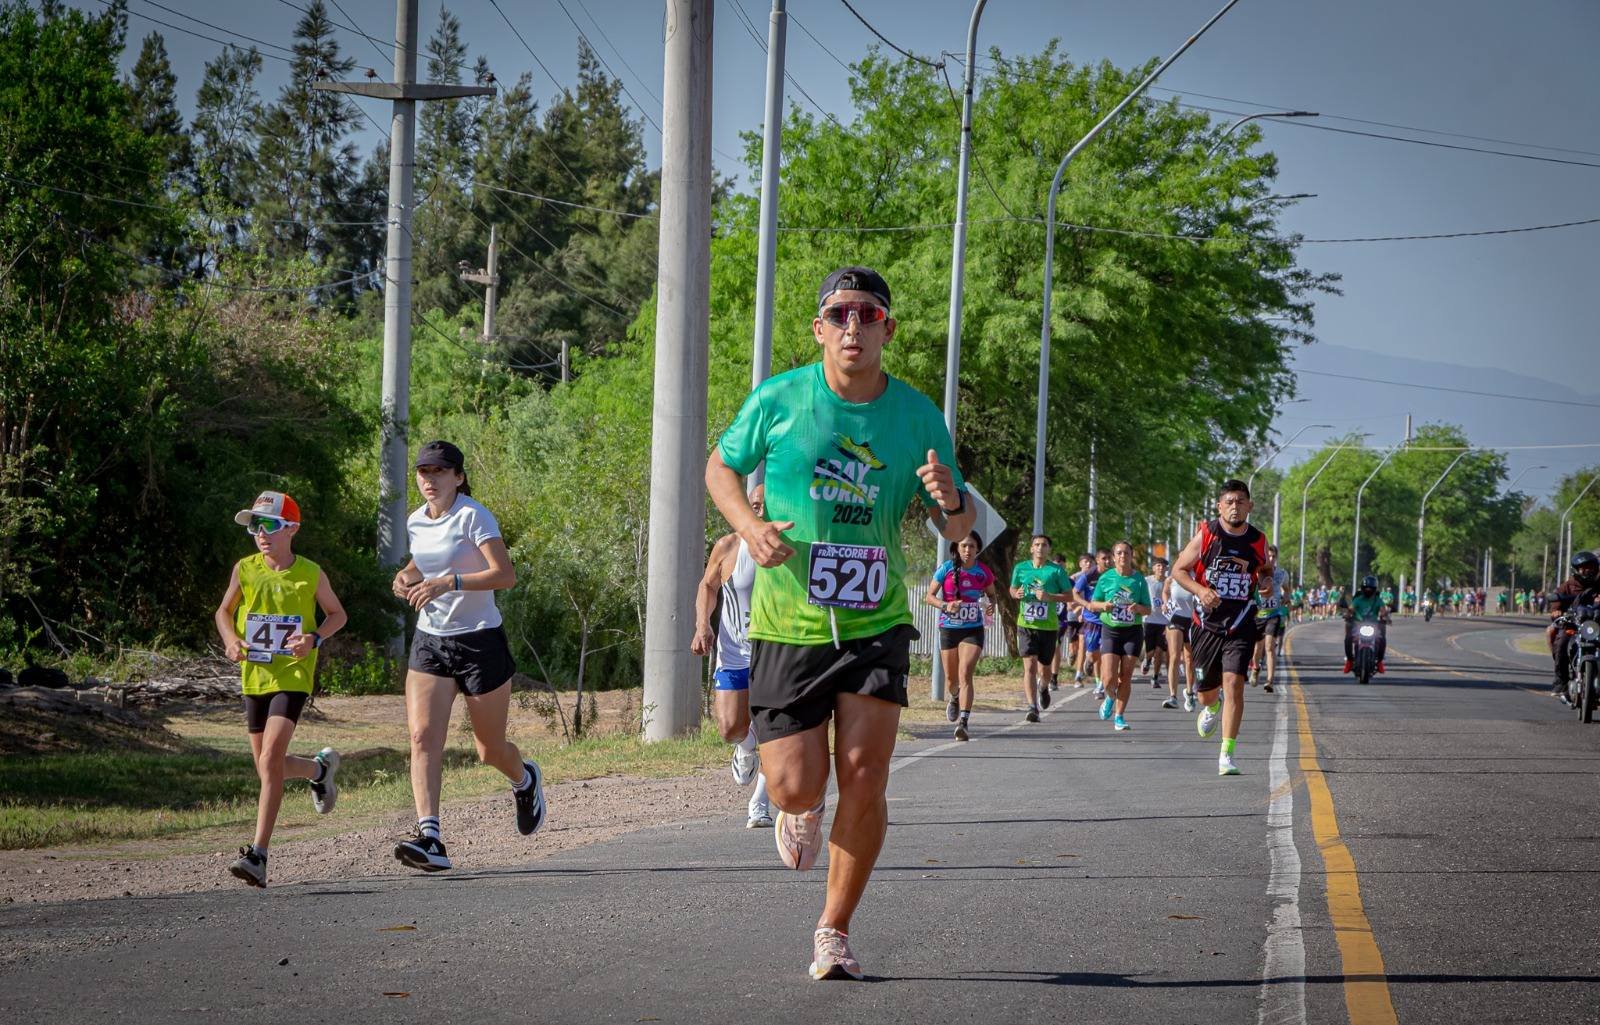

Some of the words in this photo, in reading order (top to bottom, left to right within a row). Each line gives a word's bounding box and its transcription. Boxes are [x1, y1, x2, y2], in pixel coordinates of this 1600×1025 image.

[814, 458, 873, 484] FRAY
[810, 479, 880, 506] CORRE
[832, 504, 874, 526] 2025
[810, 557, 886, 602] 520
[1217, 577, 1250, 597] 553
[1026, 604, 1045, 617] 40
[252, 622, 297, 649] 47
